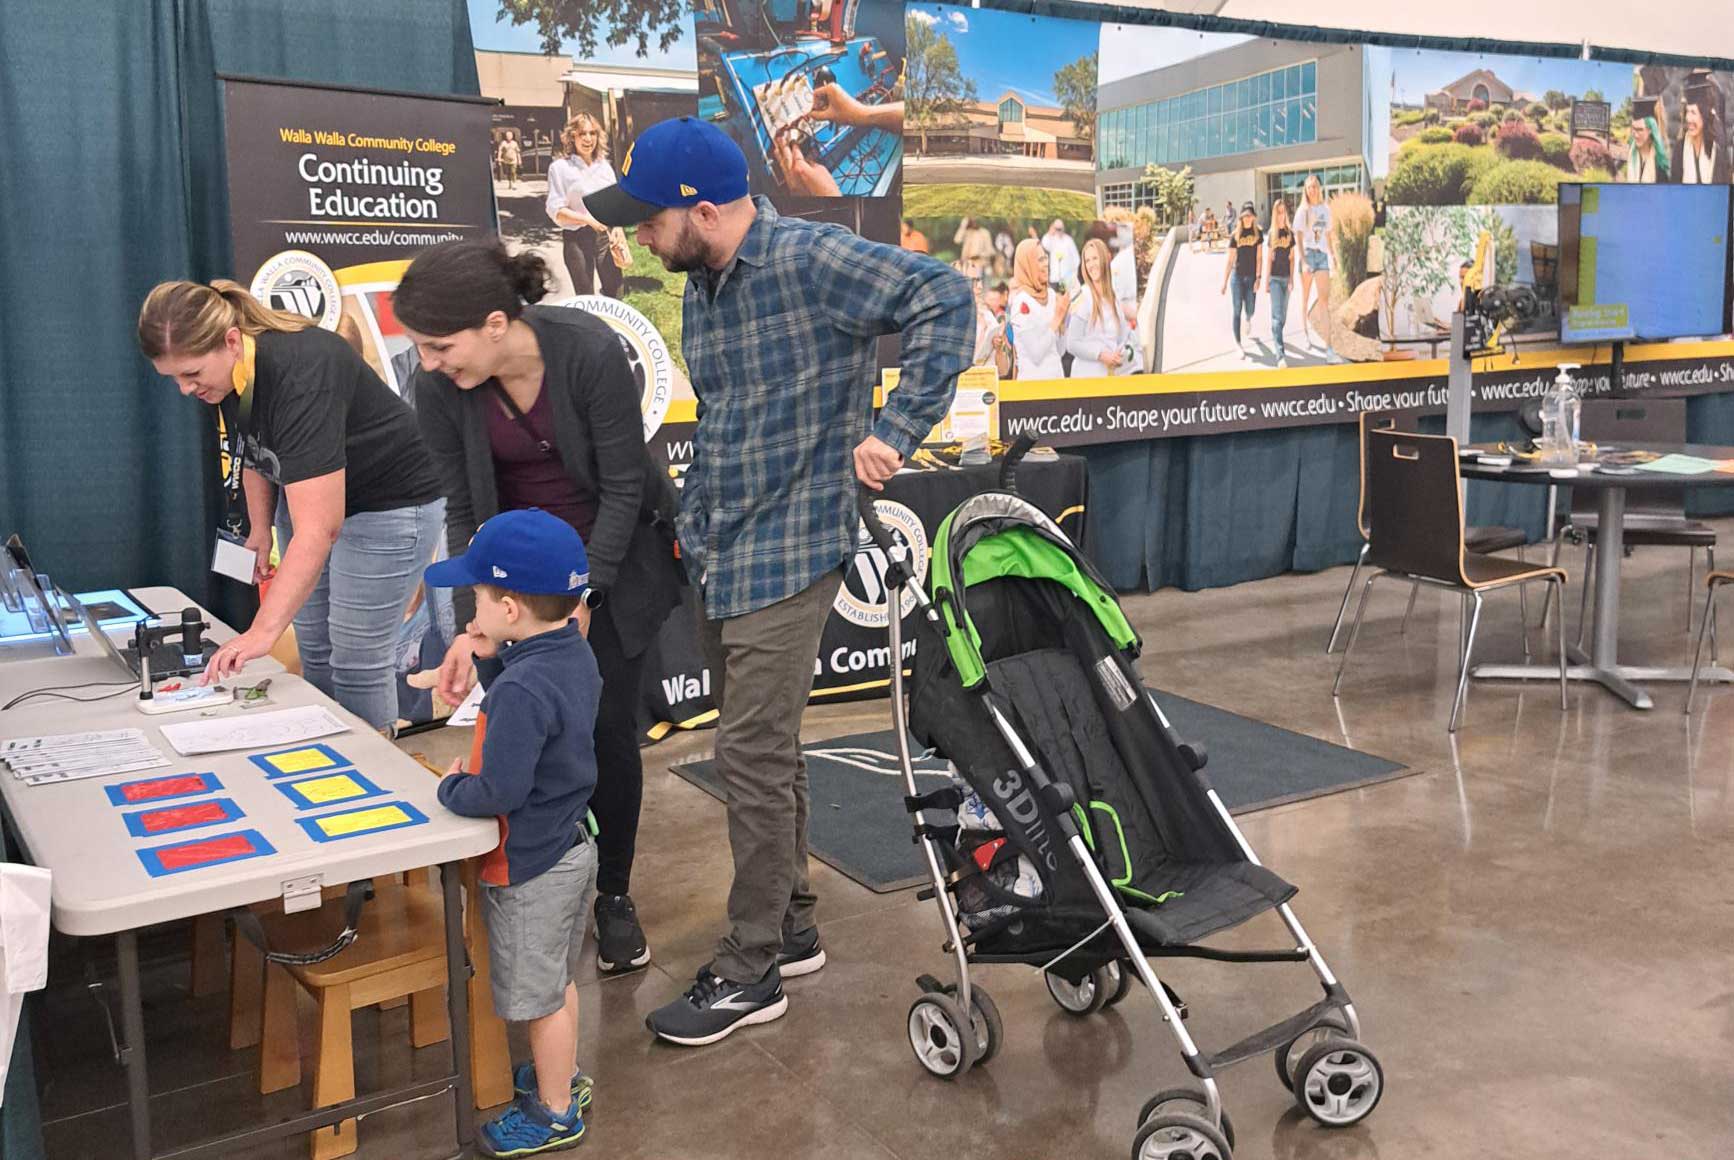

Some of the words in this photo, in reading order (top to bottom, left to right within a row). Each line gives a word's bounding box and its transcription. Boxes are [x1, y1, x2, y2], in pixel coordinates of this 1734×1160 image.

[280, 128, 312, 144] Walla
[314, 131, 345, 146] Walla
[347, 133, 414, 153] Community
[415, 138, 456, 156] College
[298, 153, 444, 195] Continuing
[308, 187, 438, 219] Education
[648, 338, 668, 404] COLLEGE
[1007, 408, 1093, 436] wwcc.edu
[1106, 405, 1158, 432] Shape
[1161, 405, 1198, 431] your
[1199, 400, 1248, 423] future
[1261, 393, 1337, 418] wwcc.edu
[1346, 390, 1391, 412] Shape
[1393, 390, 1425, 409] your
[1427, 384, 1449, 405] fut
[1481, 376, 1550, 400] wwcc.edu
[1659, 363, 1713, 386] wwcc.edu
[877, 505, 916, 528] MMUNITY
[838, 598, 888, 623] ESTABLISH
[662, 668, 711, 706] Wal
